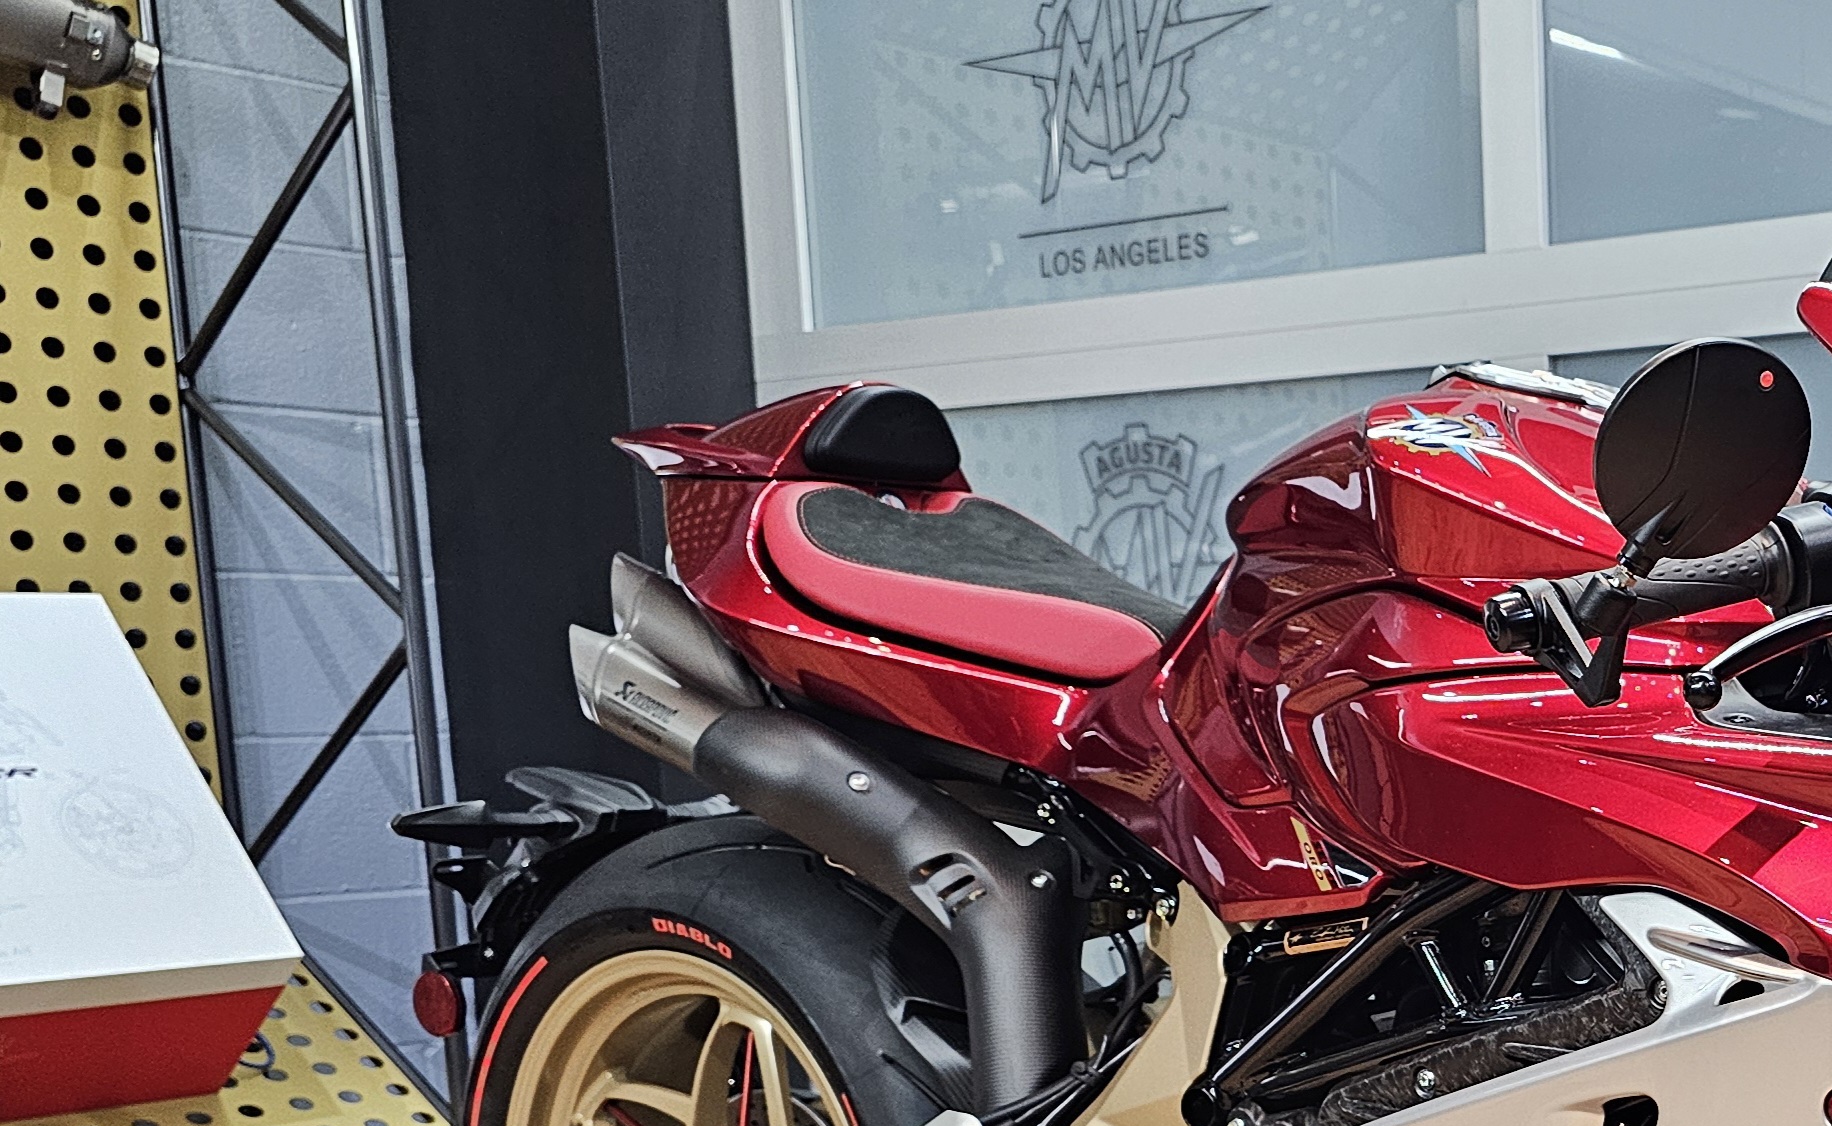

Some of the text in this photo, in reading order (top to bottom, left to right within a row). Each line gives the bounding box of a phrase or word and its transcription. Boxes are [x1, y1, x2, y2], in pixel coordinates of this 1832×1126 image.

[1039, 232, 1210, 278] LOS ANGELES
[1095, 441, 1183, 478] AGUSTA
[651, 917, 733, 960] DIABLO
